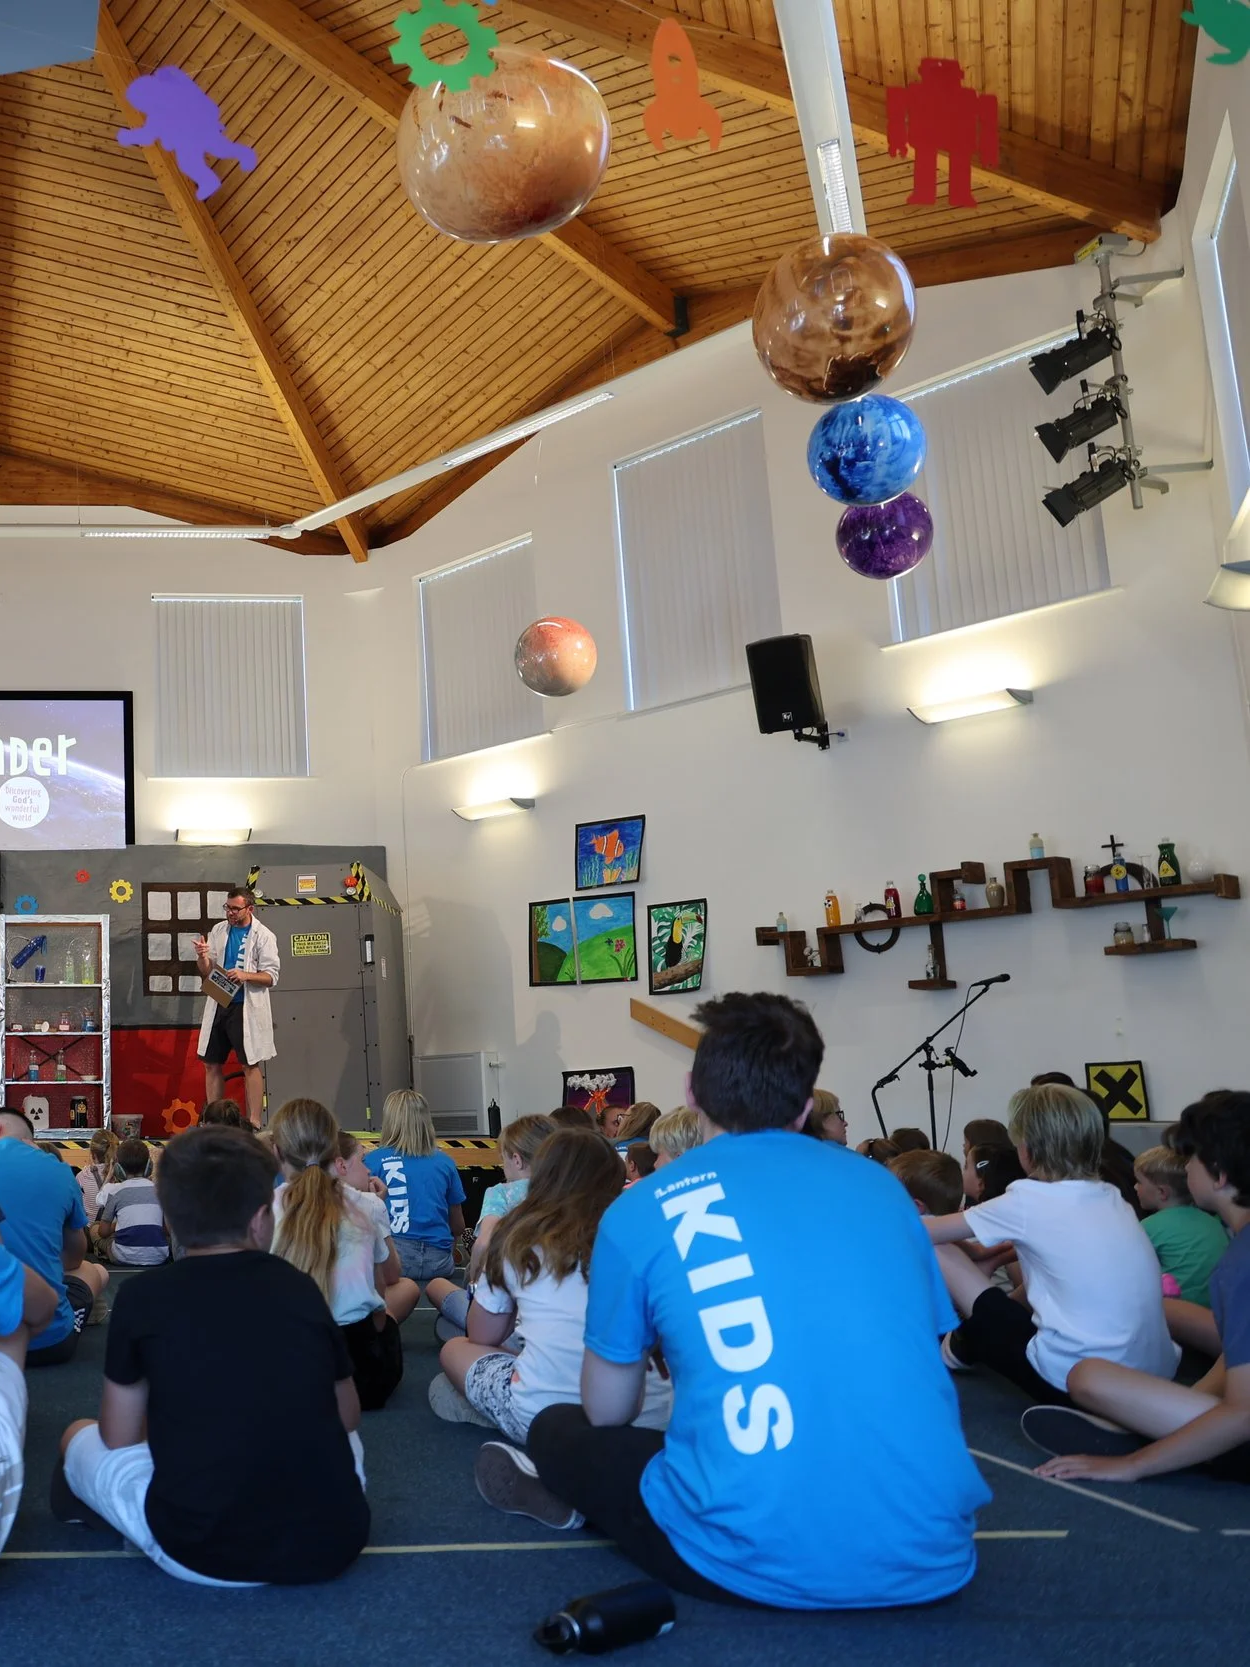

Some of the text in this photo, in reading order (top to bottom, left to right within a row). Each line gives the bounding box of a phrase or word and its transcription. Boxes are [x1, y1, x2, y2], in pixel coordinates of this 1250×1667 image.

[12, 795, 33, 804] God's
[5, 804, 40, 813] wonderful
[12, 814, 32, 822] world
[293, 934, 327, 942] CAUTION
[654, 1172, 717, 1199] Lantern
[382, 1161, 410, 1234] KIDS
[661, 1182, 794, 1455] KIDS
